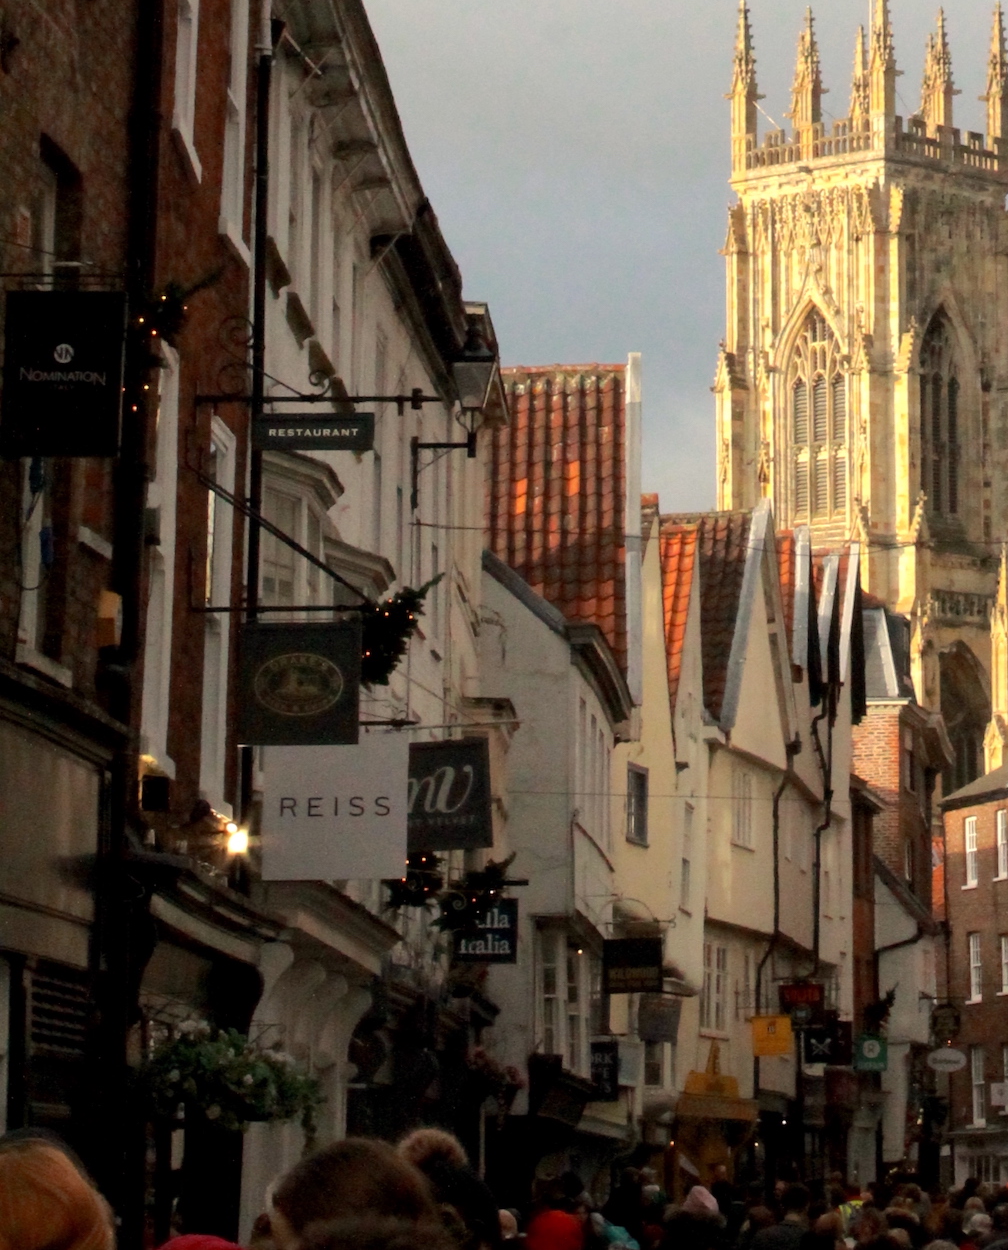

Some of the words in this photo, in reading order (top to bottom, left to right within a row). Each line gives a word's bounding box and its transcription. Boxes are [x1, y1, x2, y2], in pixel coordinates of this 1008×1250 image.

[19, 367, 106, 386] NOMINATION
[268, 428, 359, 437] RESTAURANT
[280, 796, 390, 817] REISS
